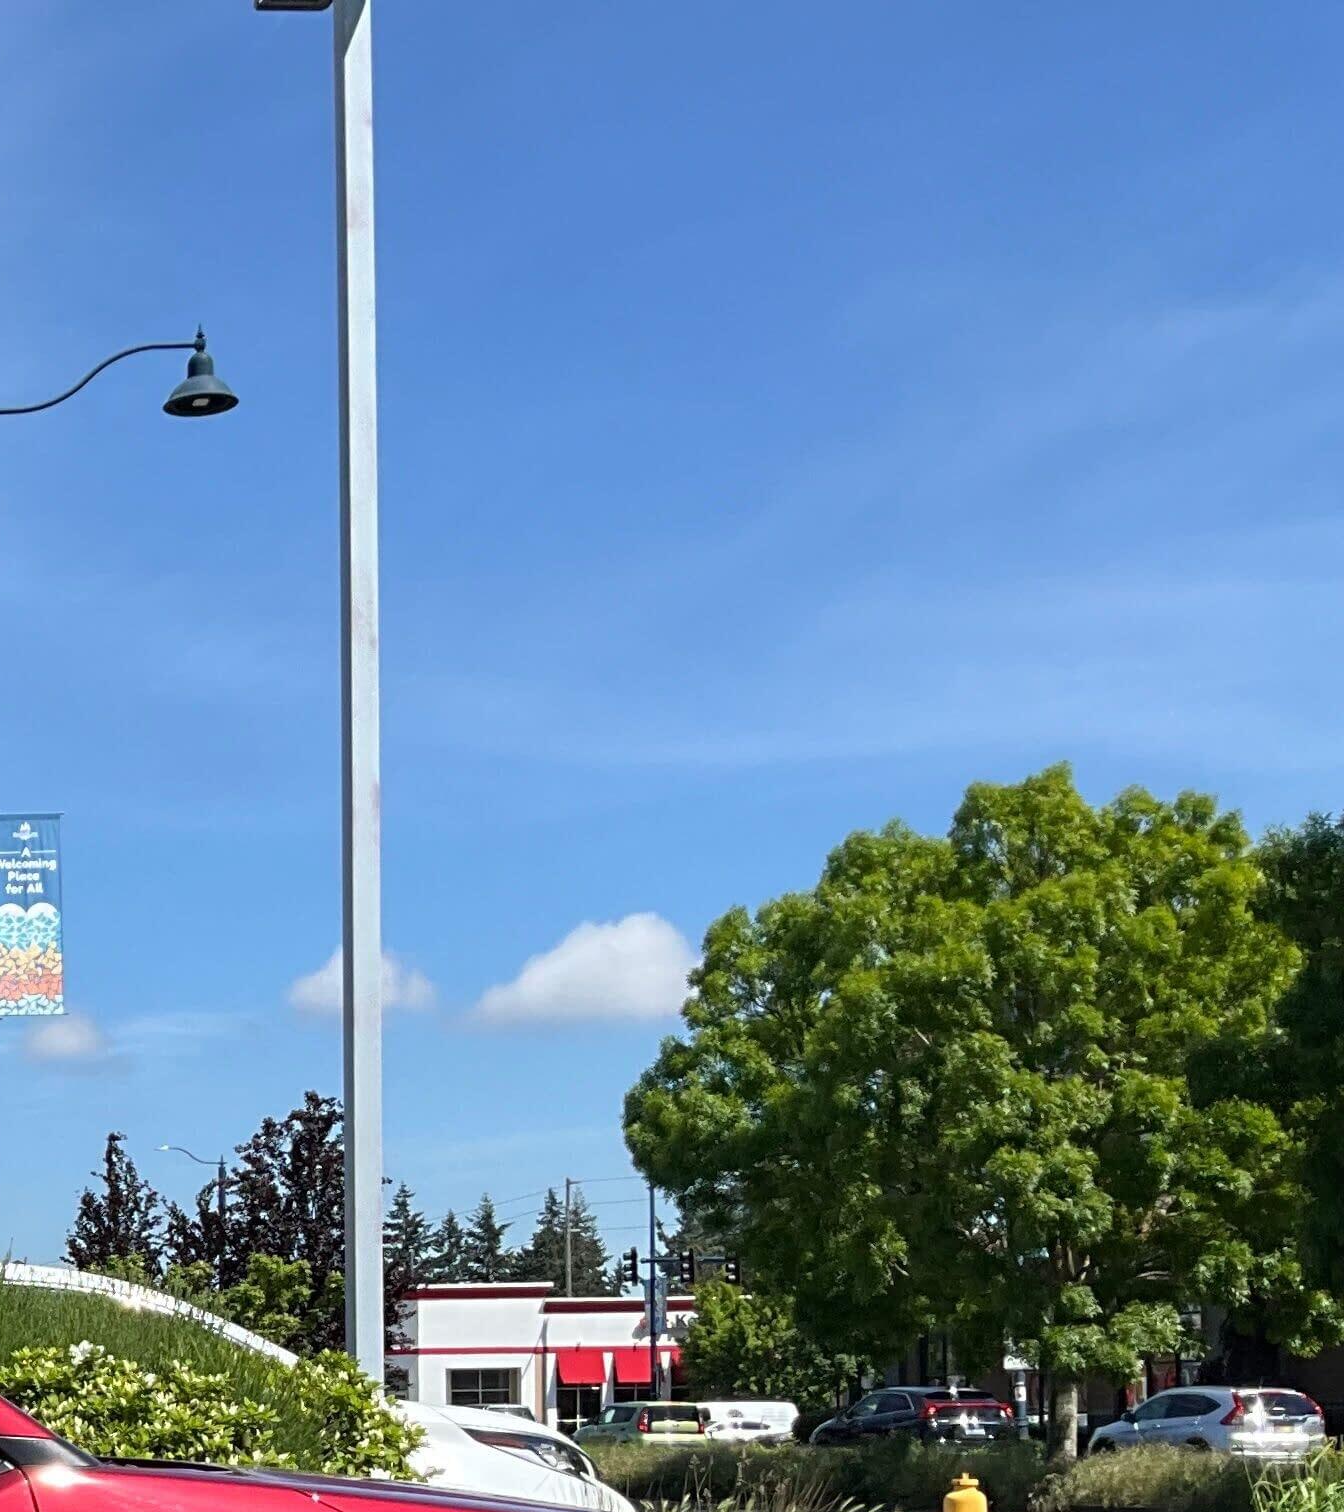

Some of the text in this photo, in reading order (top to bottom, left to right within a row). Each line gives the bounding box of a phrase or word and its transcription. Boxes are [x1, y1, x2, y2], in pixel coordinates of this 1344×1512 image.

[21, 846, 31, 858] A
[7, 870, 40, 882] Place
[5, 882, 44, 894] for All
